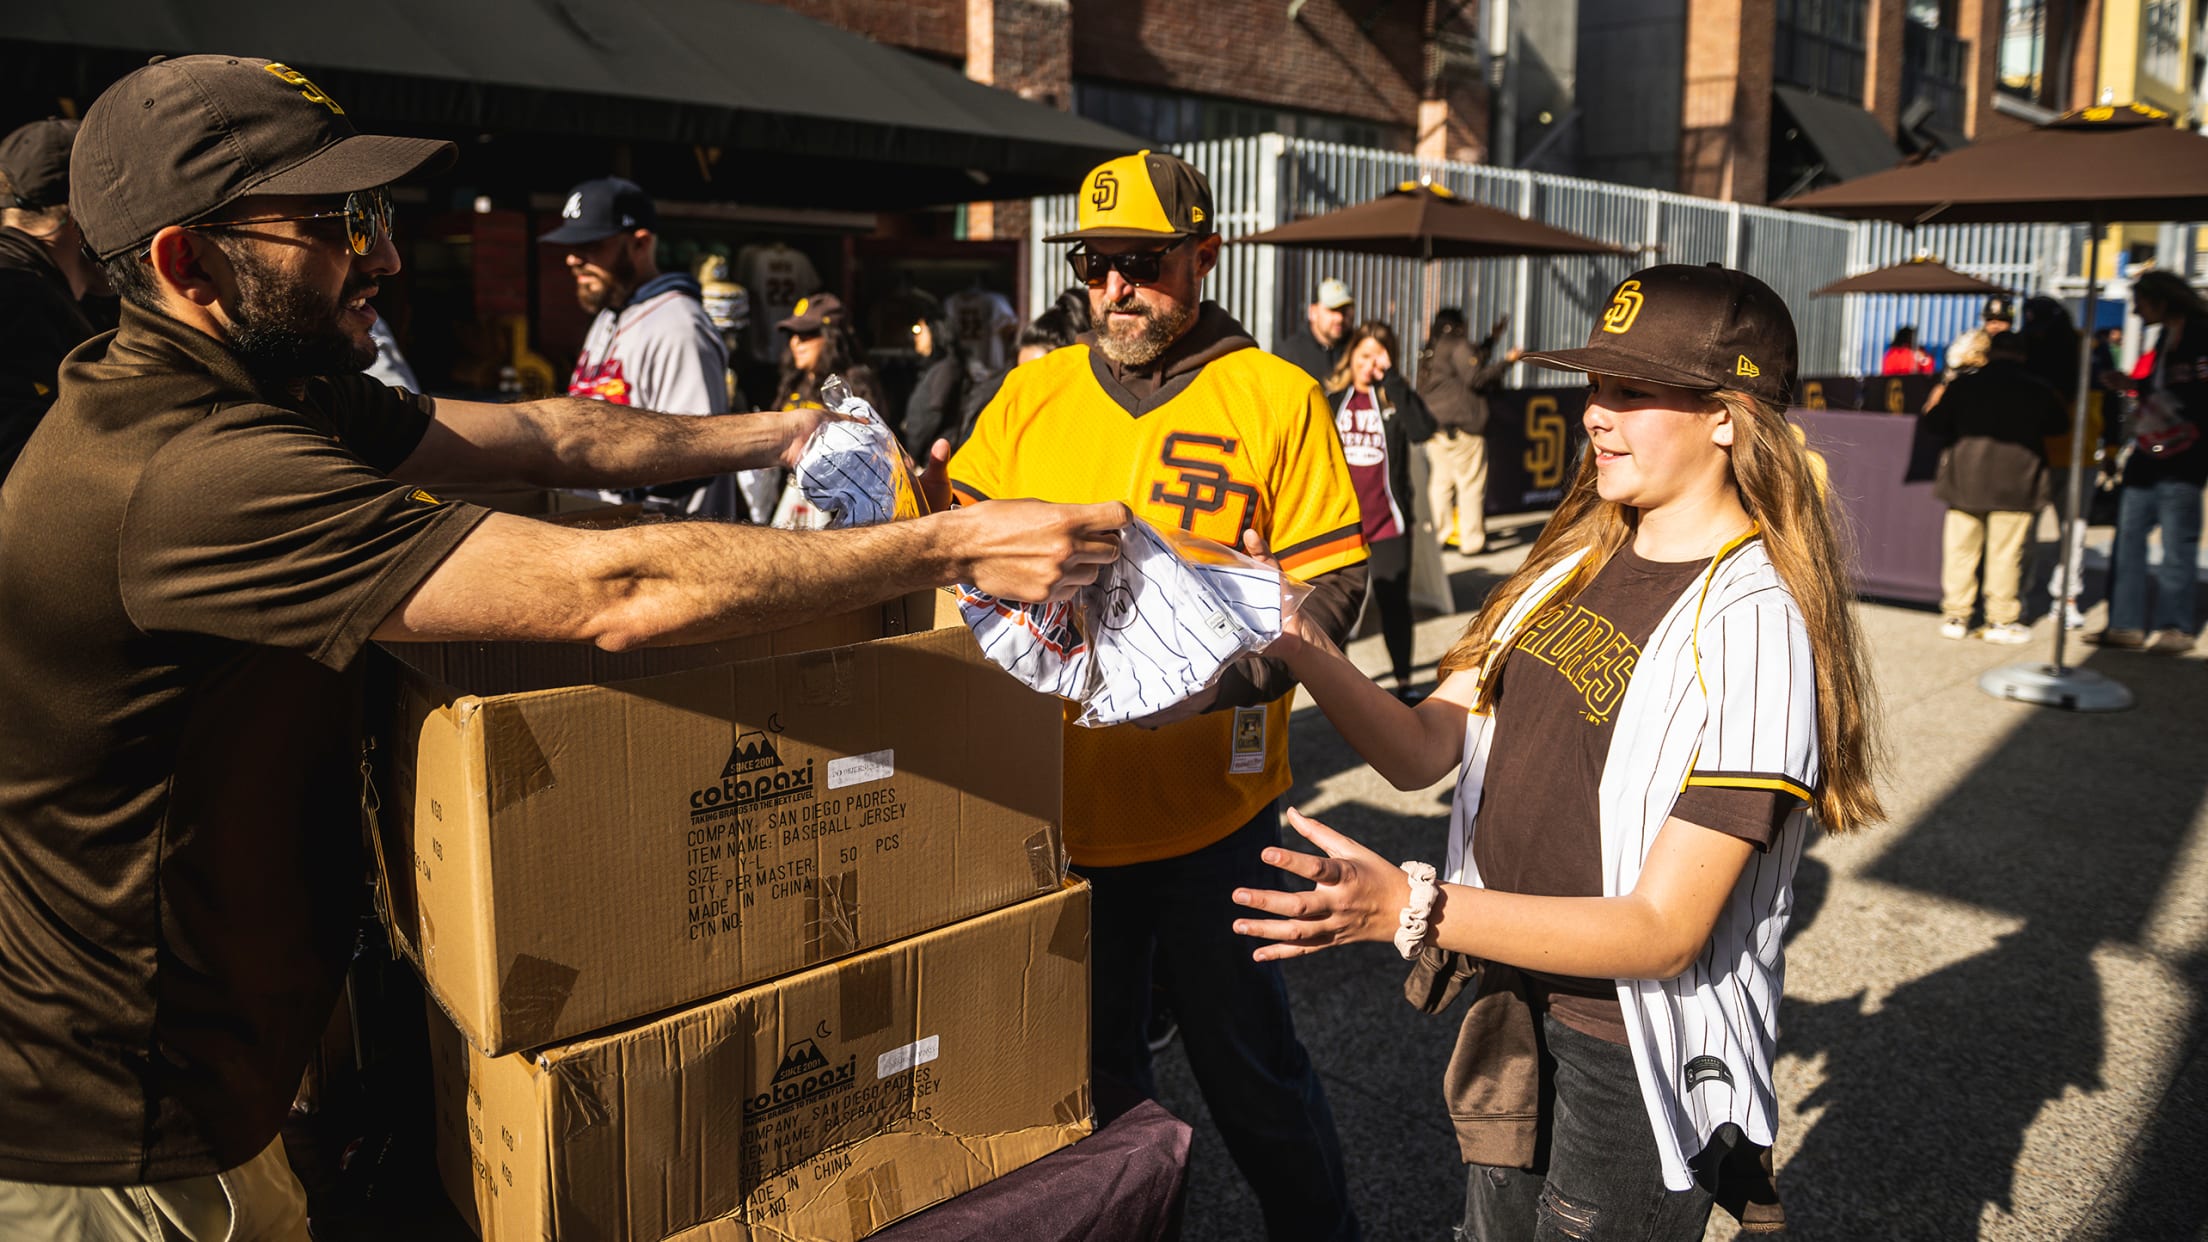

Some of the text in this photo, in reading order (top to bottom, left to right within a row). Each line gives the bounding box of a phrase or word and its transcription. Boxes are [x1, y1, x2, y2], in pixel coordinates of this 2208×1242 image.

[1515, 603, 1642, 716] ADRES
[690, 758, 814, 808] cotapaxi
[730, 756, 775, 774] SINCE 2001
[690, 790, 814, 825] TAKING BRANDS TO THE NEXT LEVEL
[768, 808, 798, 830] SAN
[802, 799, 841, 822] DIEGO
[846, 788, 896, 811] PADRES
[687, 802, 907, 867] ITEM NAME: BASEBALL JERSEY
[726, 874, 752, 895] PER
[756, 857, 816, 887] MASTER:
[840, 846, 858, 864] 50
[876, 834, 900, 854] PCS
[740, 853, 765, 873] Y-L
[688, 878, 813, 923] MADE IN CHINA
[690, 919, 717, 941] CTN
[779, 1059, 821, 1080] SINCE 2001
[774, 1125, 815, 1150] NAME:
[825, 1097, 887, 1133] BASEBALL
[895, 1079, 941, 1105] JERSEY
[796, 1101, 805, 1110] TO
[812, 1101, 839, 1120] SAN
[844, 1085, 879, 1109] DIEGO
[885, 1067, 931, 1094] PADRES
[908, 1107, 932, 1124] PCS
[750, 1153, 853, 1207] ADE IN CHINA
